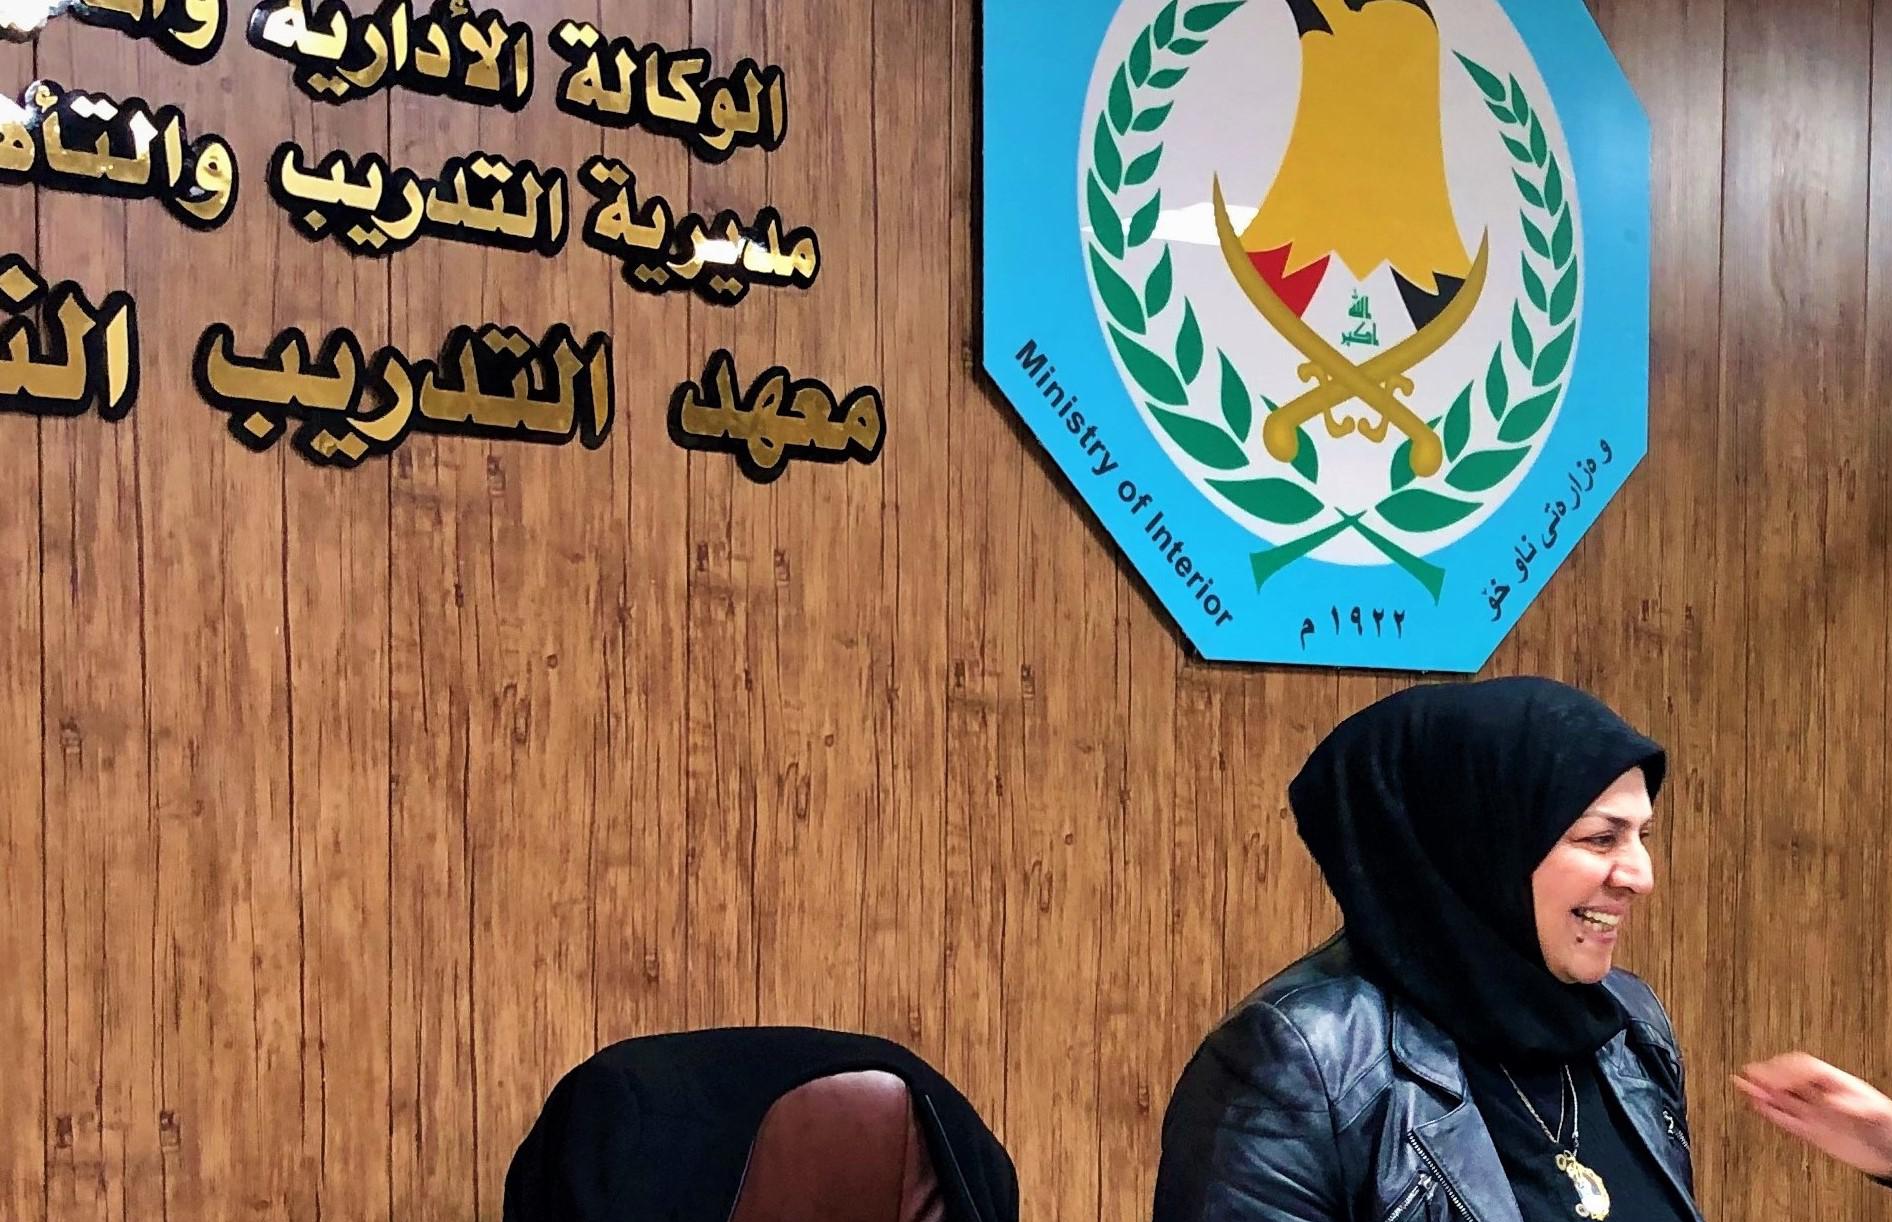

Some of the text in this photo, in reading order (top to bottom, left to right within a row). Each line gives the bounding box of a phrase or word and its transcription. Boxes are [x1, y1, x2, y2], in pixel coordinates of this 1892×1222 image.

[554, 18, 785, 155] الوكالة
[277, 149, 564, 250] التدريب
[586, 160, 818, 298] مديرية
[205, 327, 610, 461] التدريب
[678, 356, 882, 469] معهد
[1014, 338, 1234, 627] Ministry of Interior
[1330, 604, 1406, 640] ١٩٢٢
